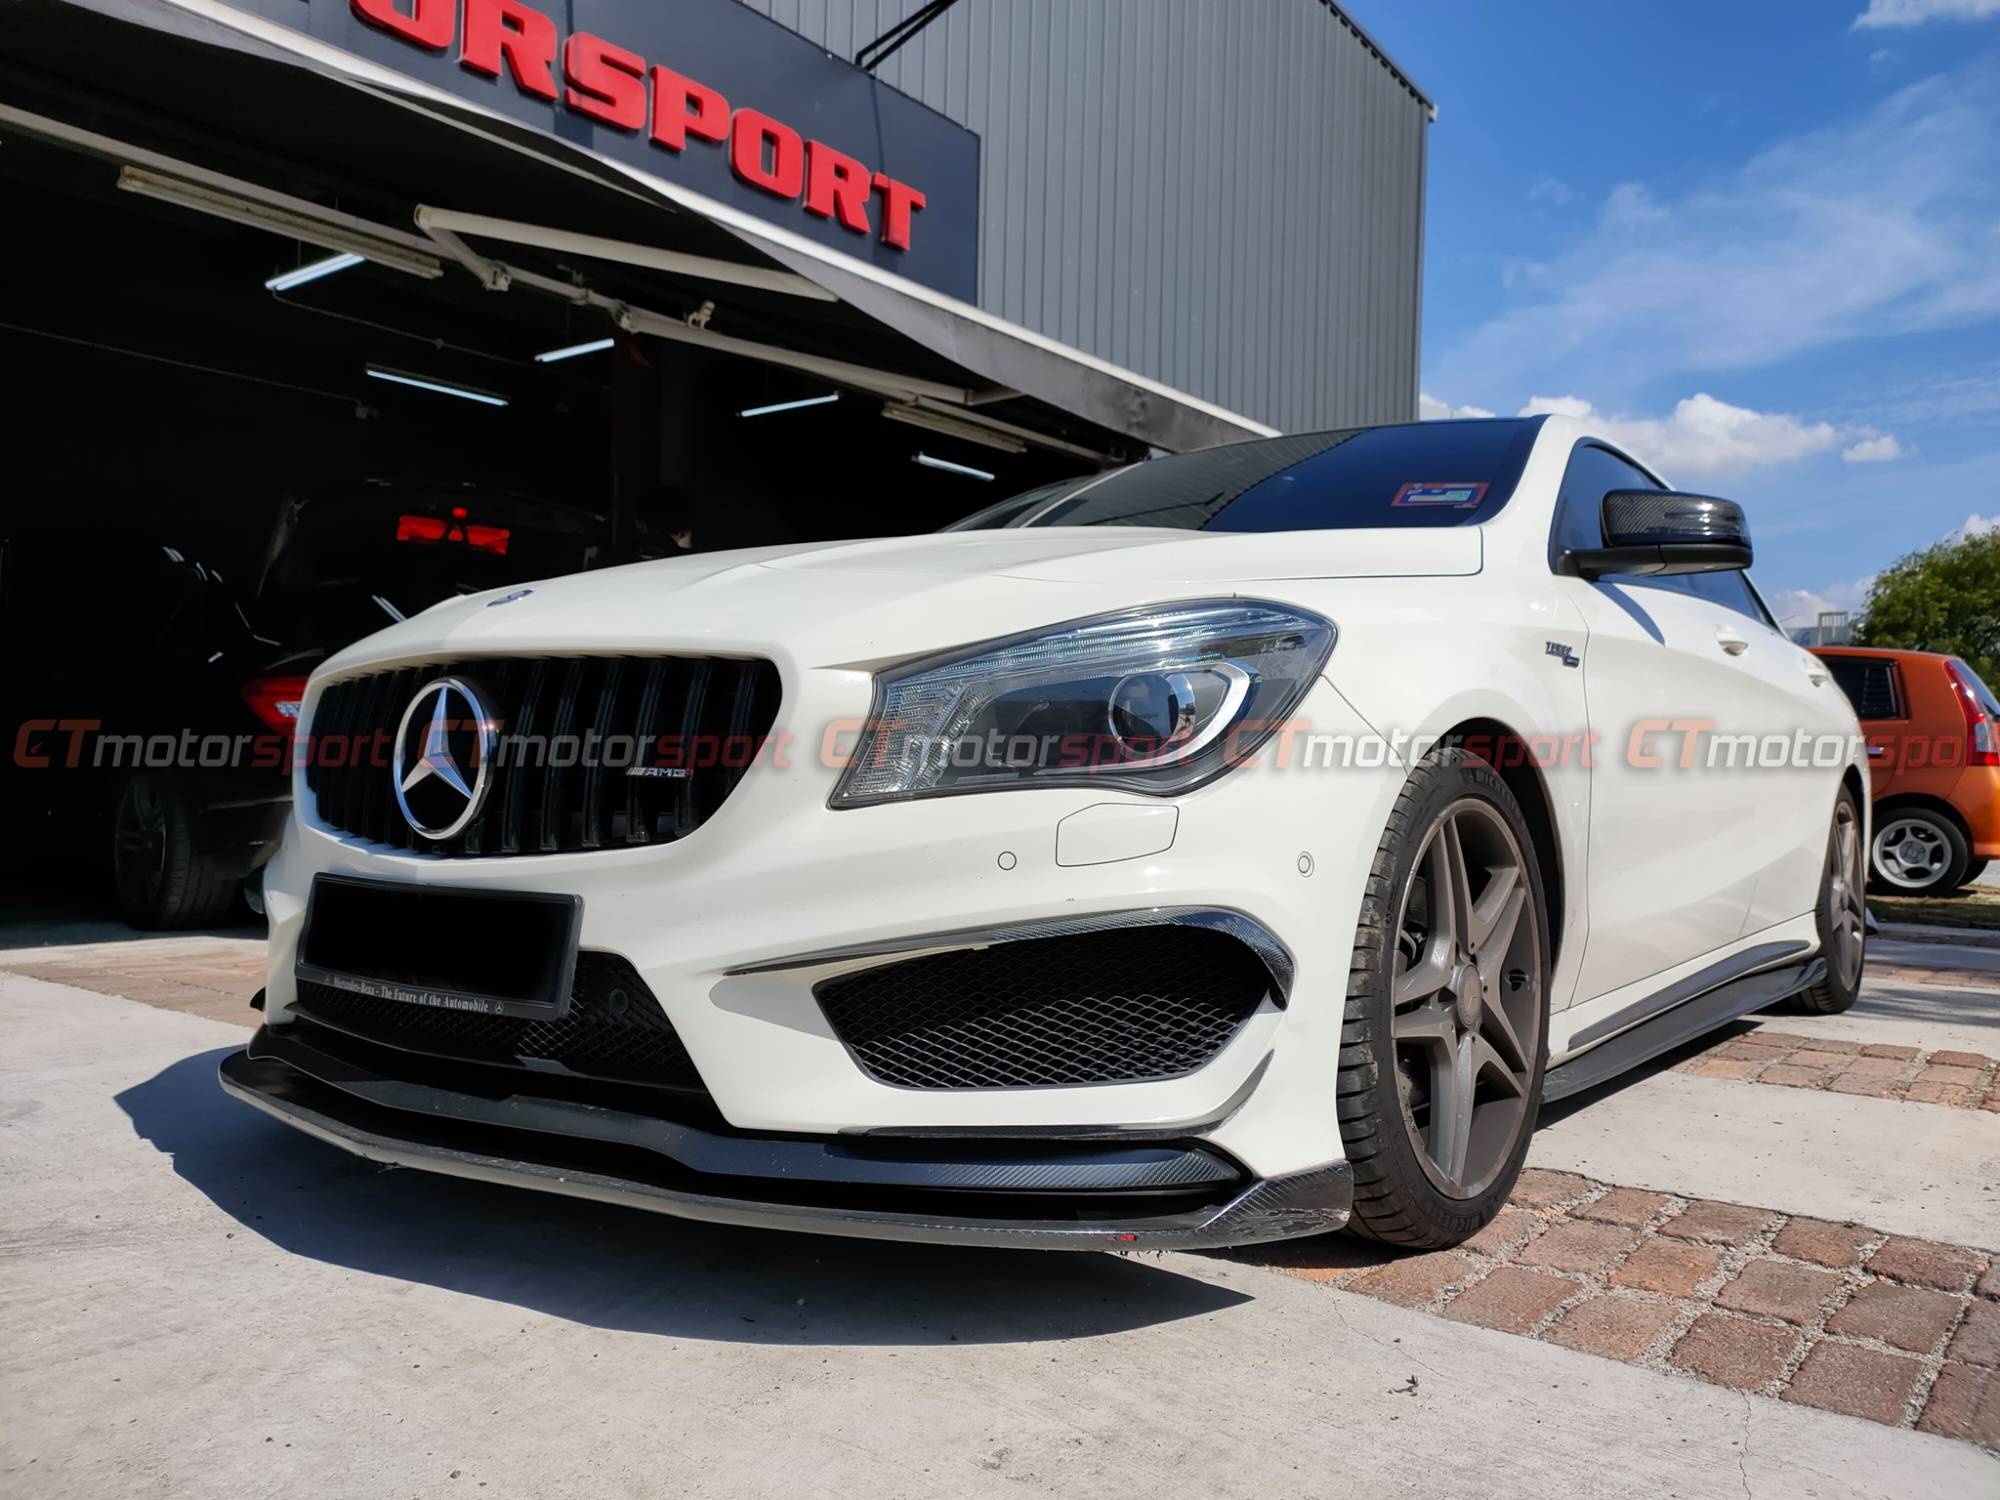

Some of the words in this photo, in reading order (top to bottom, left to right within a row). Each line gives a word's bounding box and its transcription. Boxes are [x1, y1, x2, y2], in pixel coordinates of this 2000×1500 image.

[381, 985, 393, 999] The
[394, 988, 417, 1004] Future
[418, 992, 428, 1005] of
[429, 993, 441, 1007] the
[444, 996, 489, 1013] Automobile
